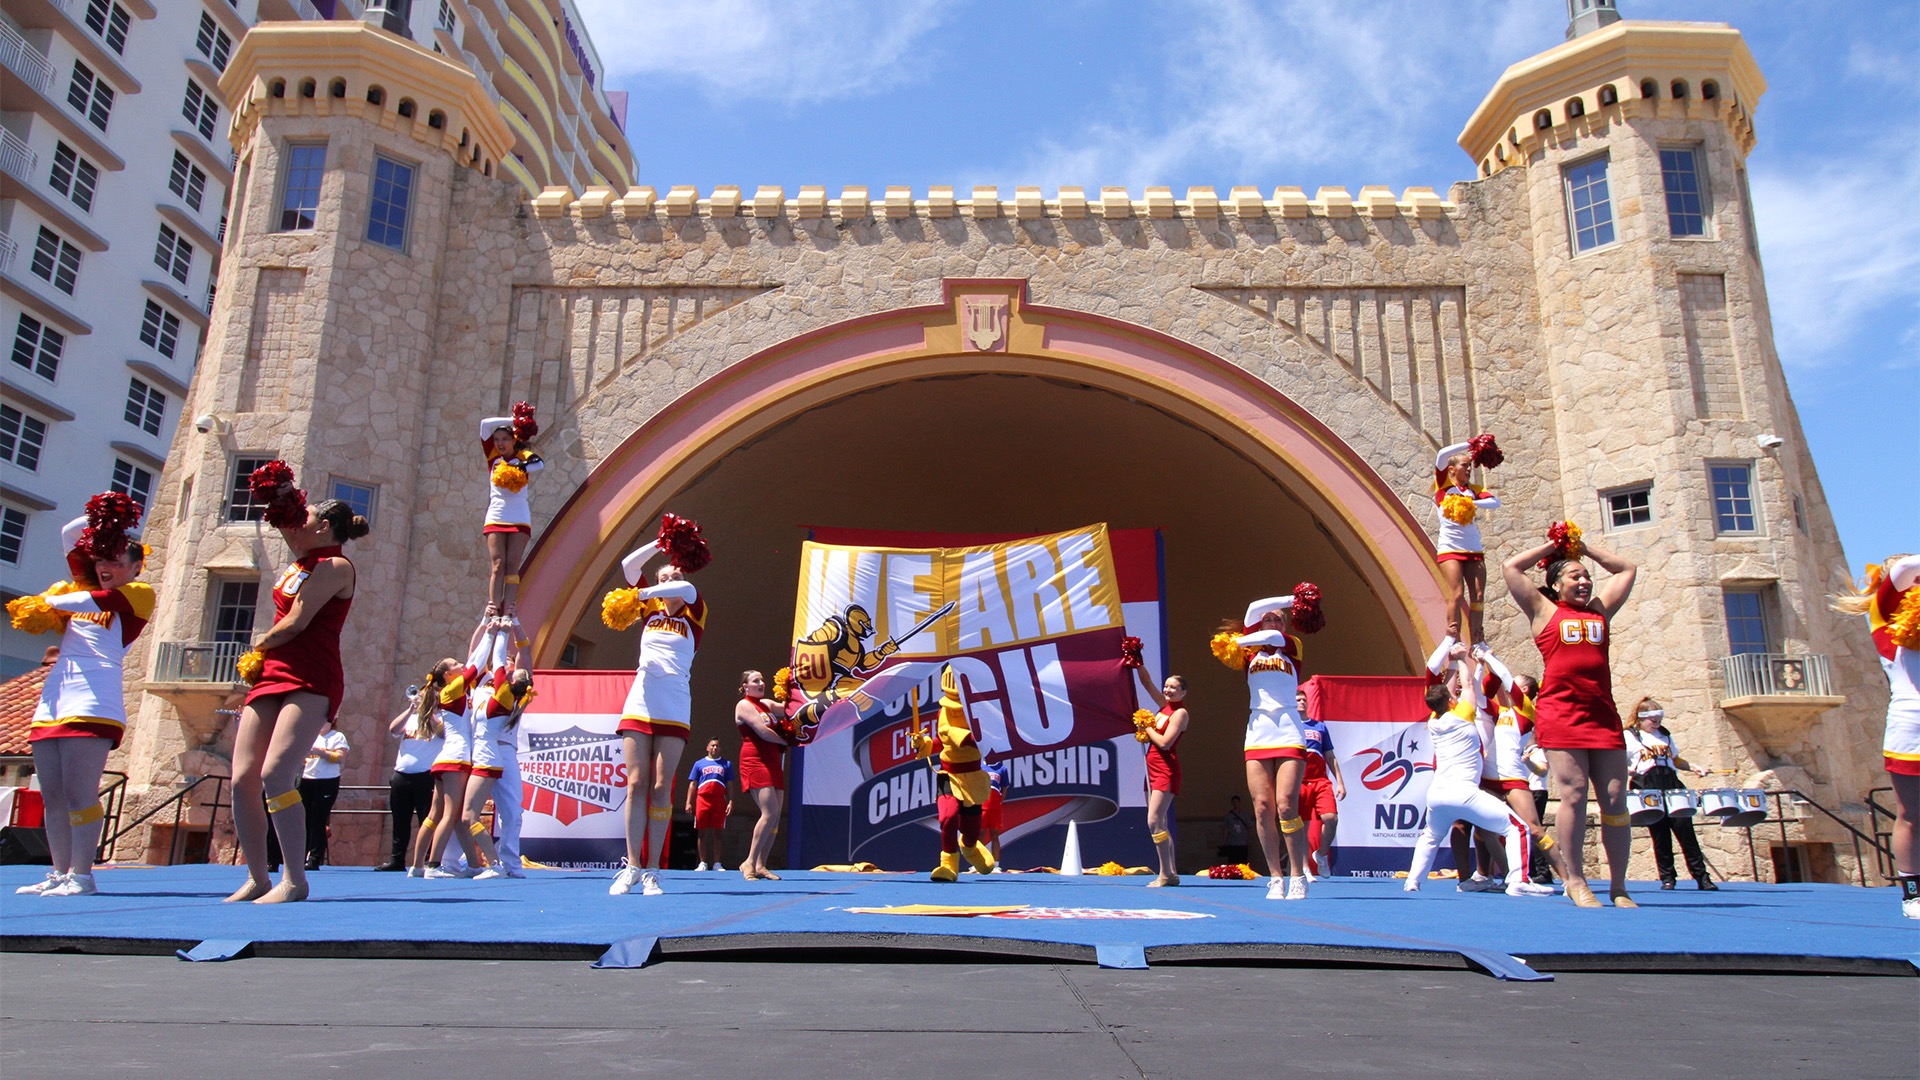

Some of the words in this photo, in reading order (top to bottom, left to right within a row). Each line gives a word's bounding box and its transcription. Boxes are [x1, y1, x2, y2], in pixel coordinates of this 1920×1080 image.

[806, 548, 936, 655] WE
[959, 533, 1111, 650] ARE
[1560, 619, 1604, 645] GU
[799, 652, 827, 680] GU
[952, 643, 1075, 753] GU
[537, 745, 613, 761] NATIONAL
[518, 763, 628, 787] CHEERLEADERS
[528, 775, 610, 803] ASSOCIATION
[1644, 795, 1659, 807] G
[1749, 795, 1760, 807] U
[572, 861, 605, 869] WORTH
[1351, 870, 1370, 878] THE
